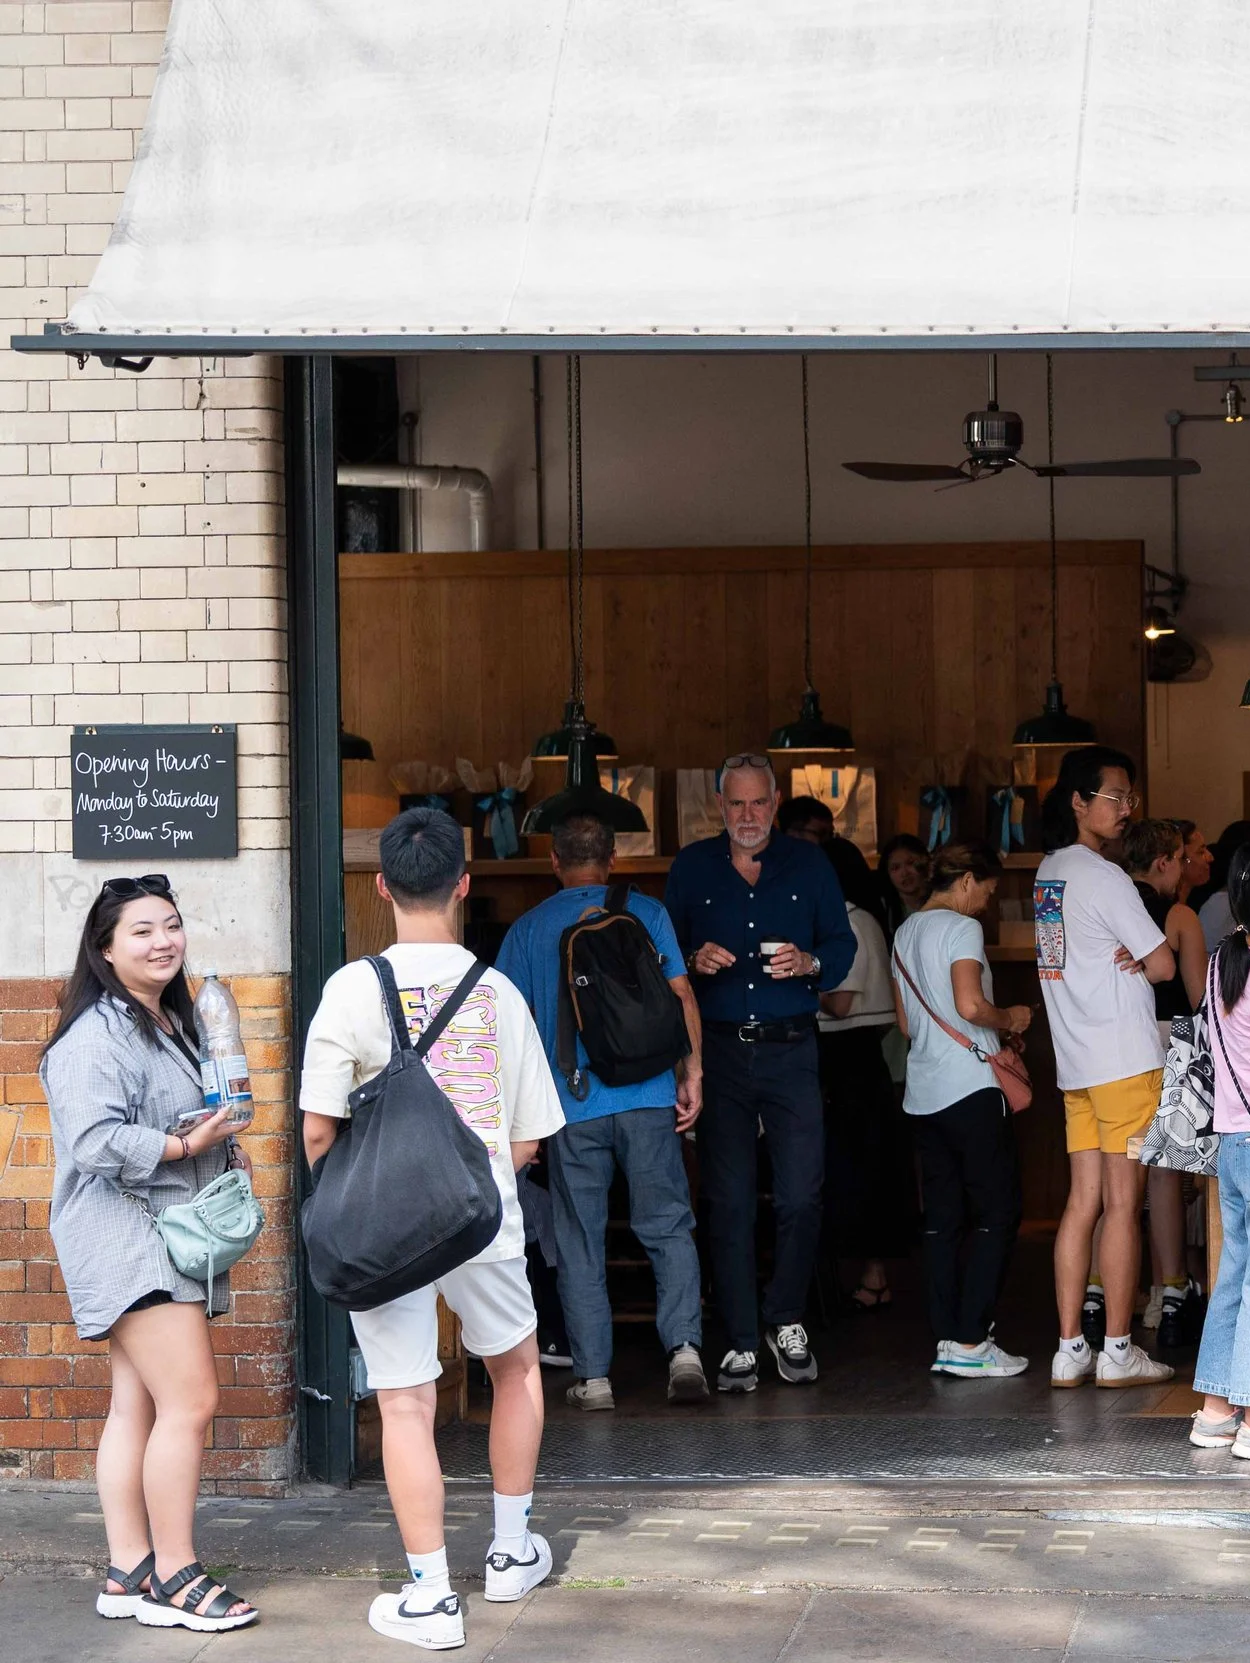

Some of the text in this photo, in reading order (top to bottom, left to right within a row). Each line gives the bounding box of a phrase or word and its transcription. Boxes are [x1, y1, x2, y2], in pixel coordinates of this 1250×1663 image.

[75, 748, 149, 788] Opening
[76, 789, 219, 821] Monday to Saturday
